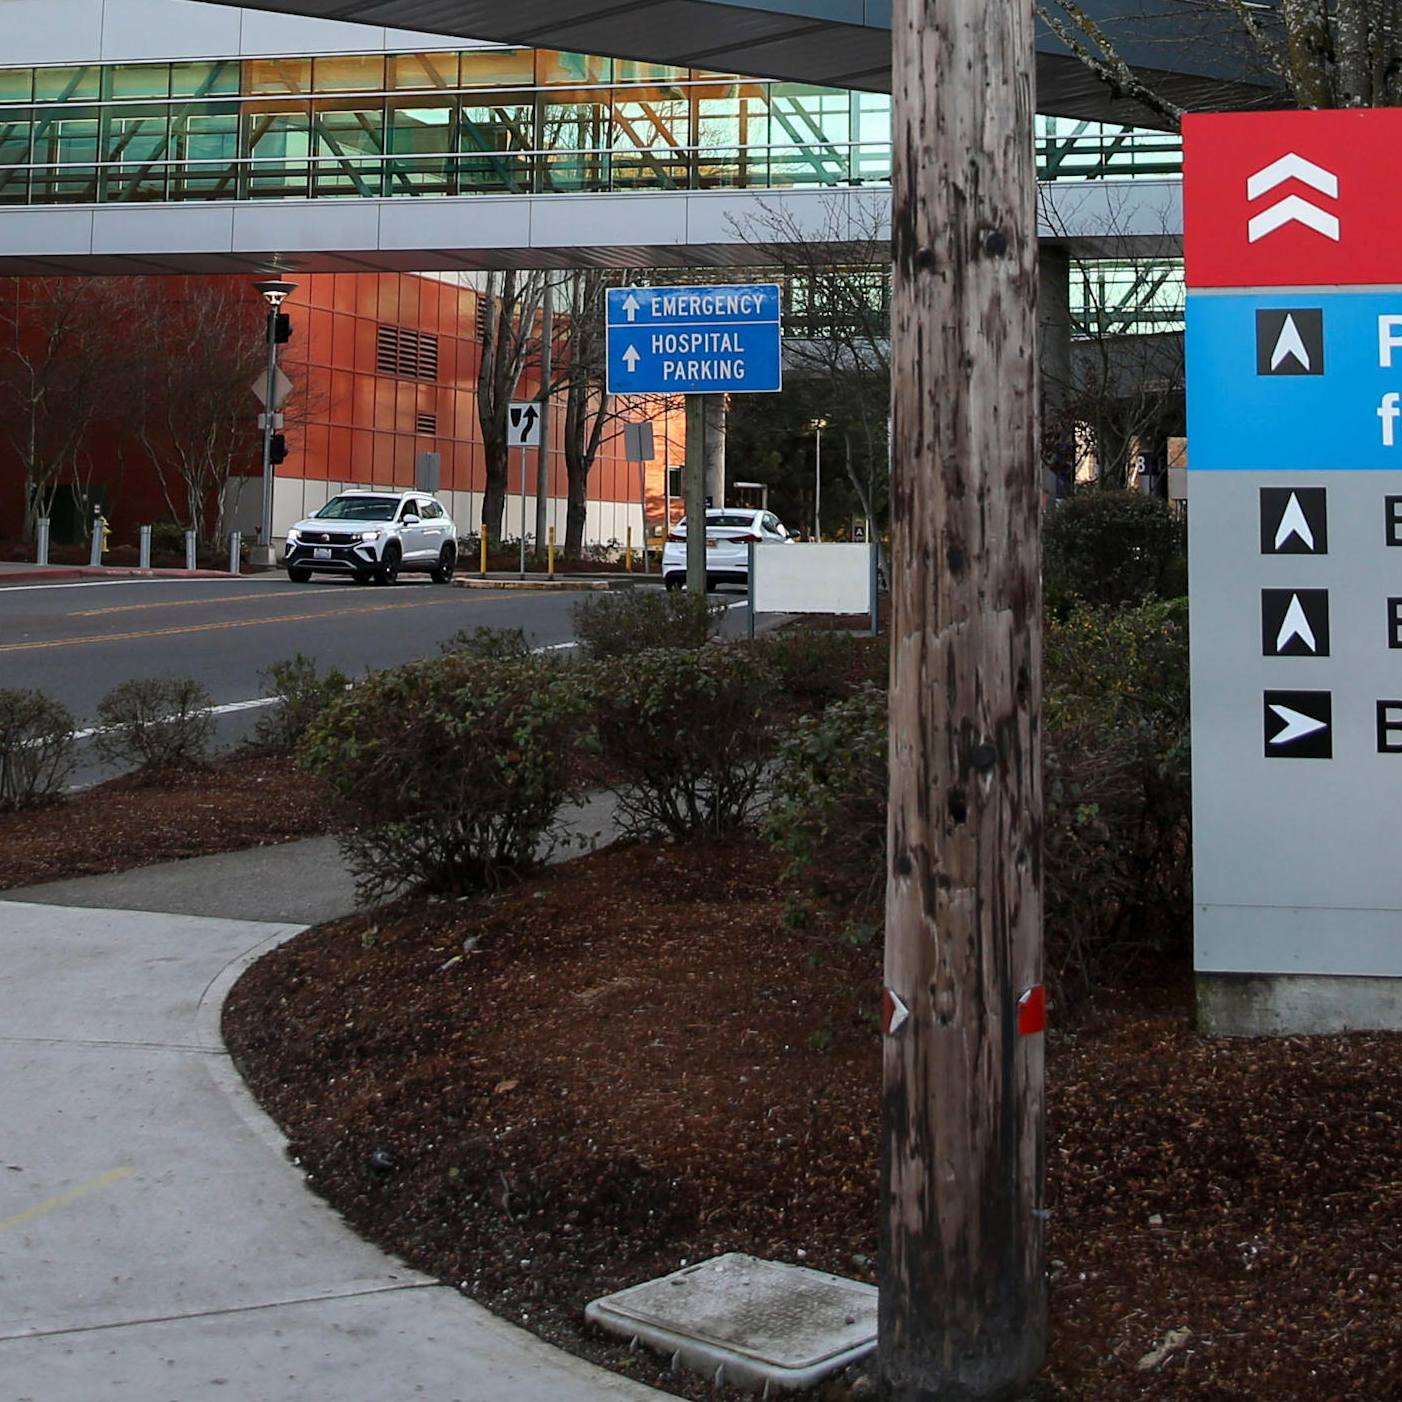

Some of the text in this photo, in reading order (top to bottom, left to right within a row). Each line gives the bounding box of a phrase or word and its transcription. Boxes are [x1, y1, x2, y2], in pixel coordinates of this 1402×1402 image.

[651, 294, 764, 317] EMERGENCY
[651, 332, 745, 354] HOSPITAL
[663, 360, 745, 381] PARKING
